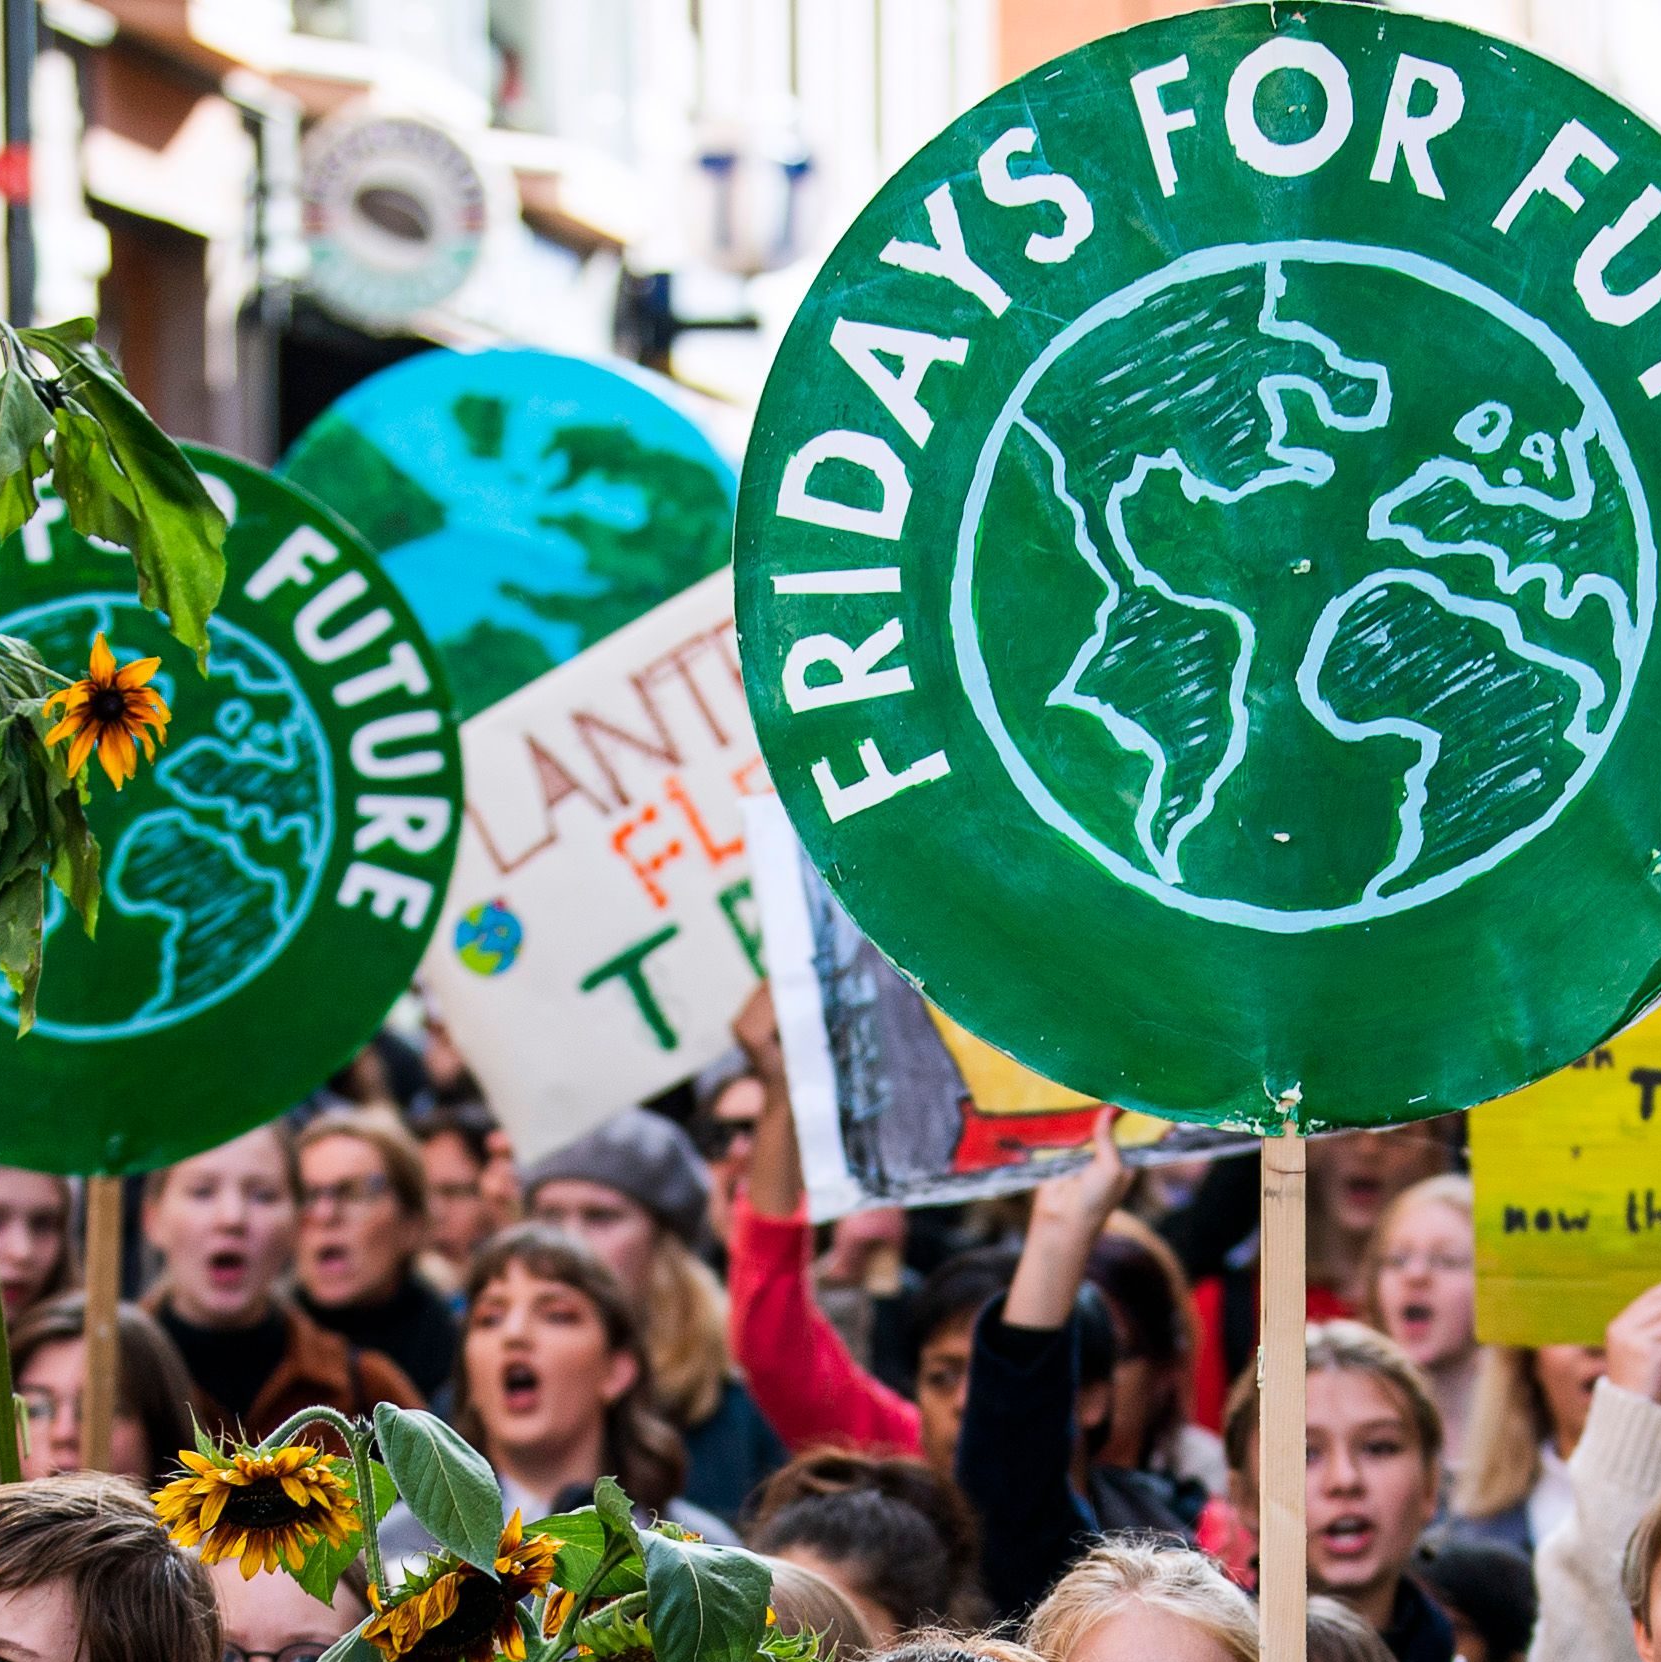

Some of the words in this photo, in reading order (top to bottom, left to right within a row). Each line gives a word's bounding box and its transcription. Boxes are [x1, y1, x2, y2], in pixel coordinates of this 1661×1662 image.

[770, 126, 1095, 824] FRIDAYS
[1130, 37, 1465, 200] FOR
[243, 524, 453, 931] FUTURE
[1503, 1203, 1590, 1235] now
